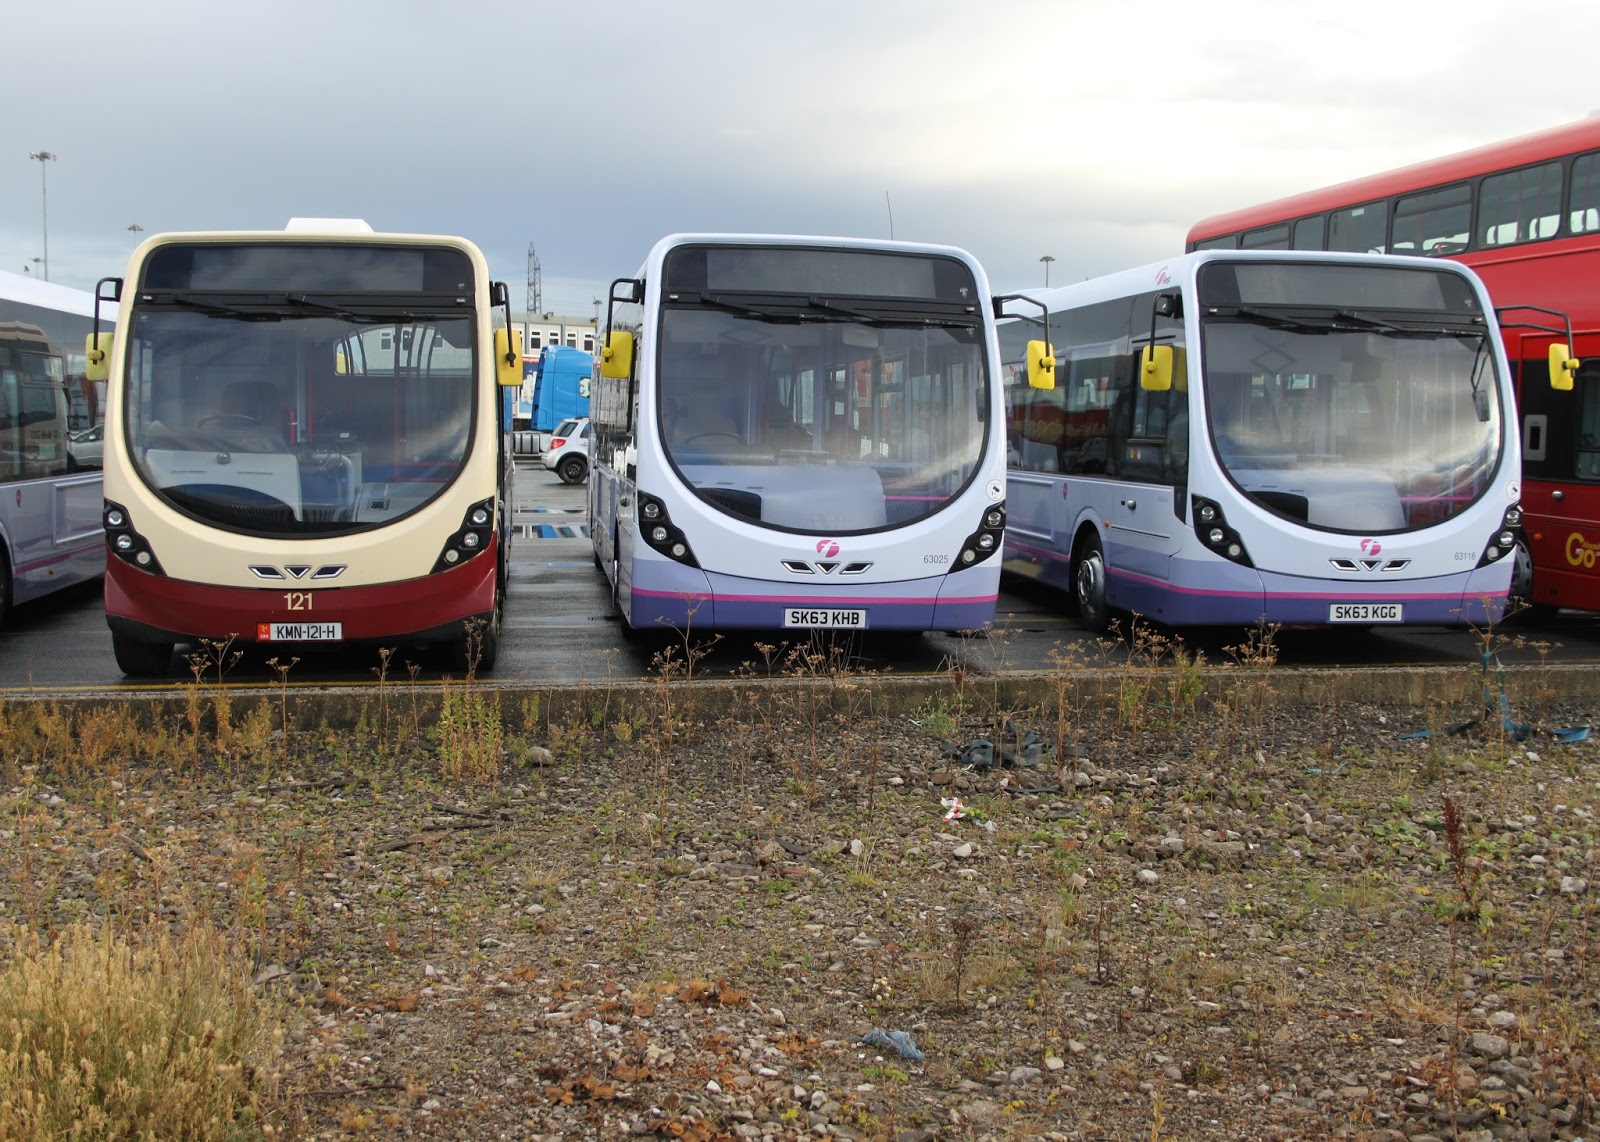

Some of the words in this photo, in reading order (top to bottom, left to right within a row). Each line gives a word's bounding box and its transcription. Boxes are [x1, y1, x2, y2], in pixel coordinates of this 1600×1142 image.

[1454, 551, 1476, 561] 63116
[1566, 532, 1596, 568] Go
[923, 554, 949, 564] 63025
[283, 592, 313, 611] 121
[791, 611, 828, 624] SK63
[832, 611, 860, 625] KHB
[1335, 606, 1369, 619] SK63
[1372, 606, 1397, 619] KGG
[276, 625, 335, 639] KMN-121-H
